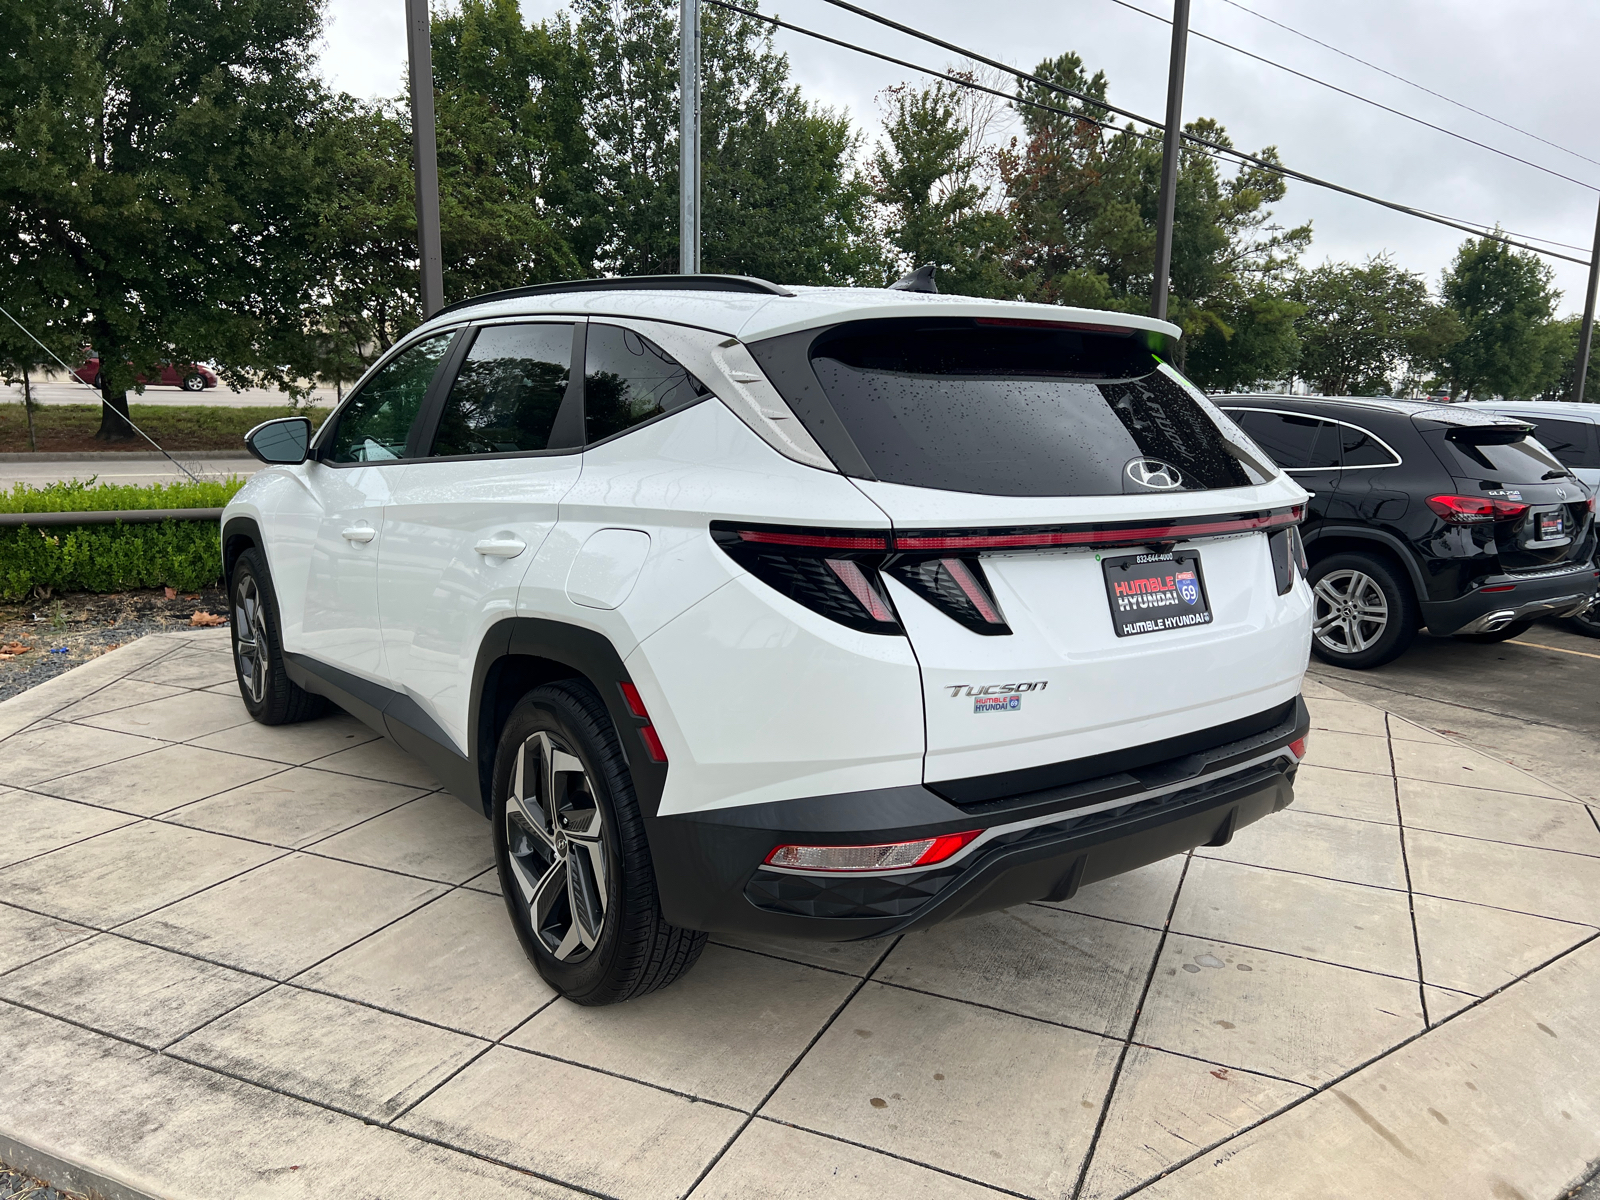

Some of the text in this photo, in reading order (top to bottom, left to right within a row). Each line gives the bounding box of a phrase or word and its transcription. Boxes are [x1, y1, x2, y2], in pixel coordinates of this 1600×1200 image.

[1136, 552, 1173, 564] 832-644-4000
[1114, 576, 1175, 596] HUMBLE
[1182, 585, 1196, 600] 69
[1119, 591, 1178, 611] HYUNDAI
[1123, 619, 1164, 634] HUMBLE
[1165, 613, 1204, 628] HYUNDAI
[944, 681, 1048, 697] TUCSON
[976, 703, 1008, 711] HYUNDAI
